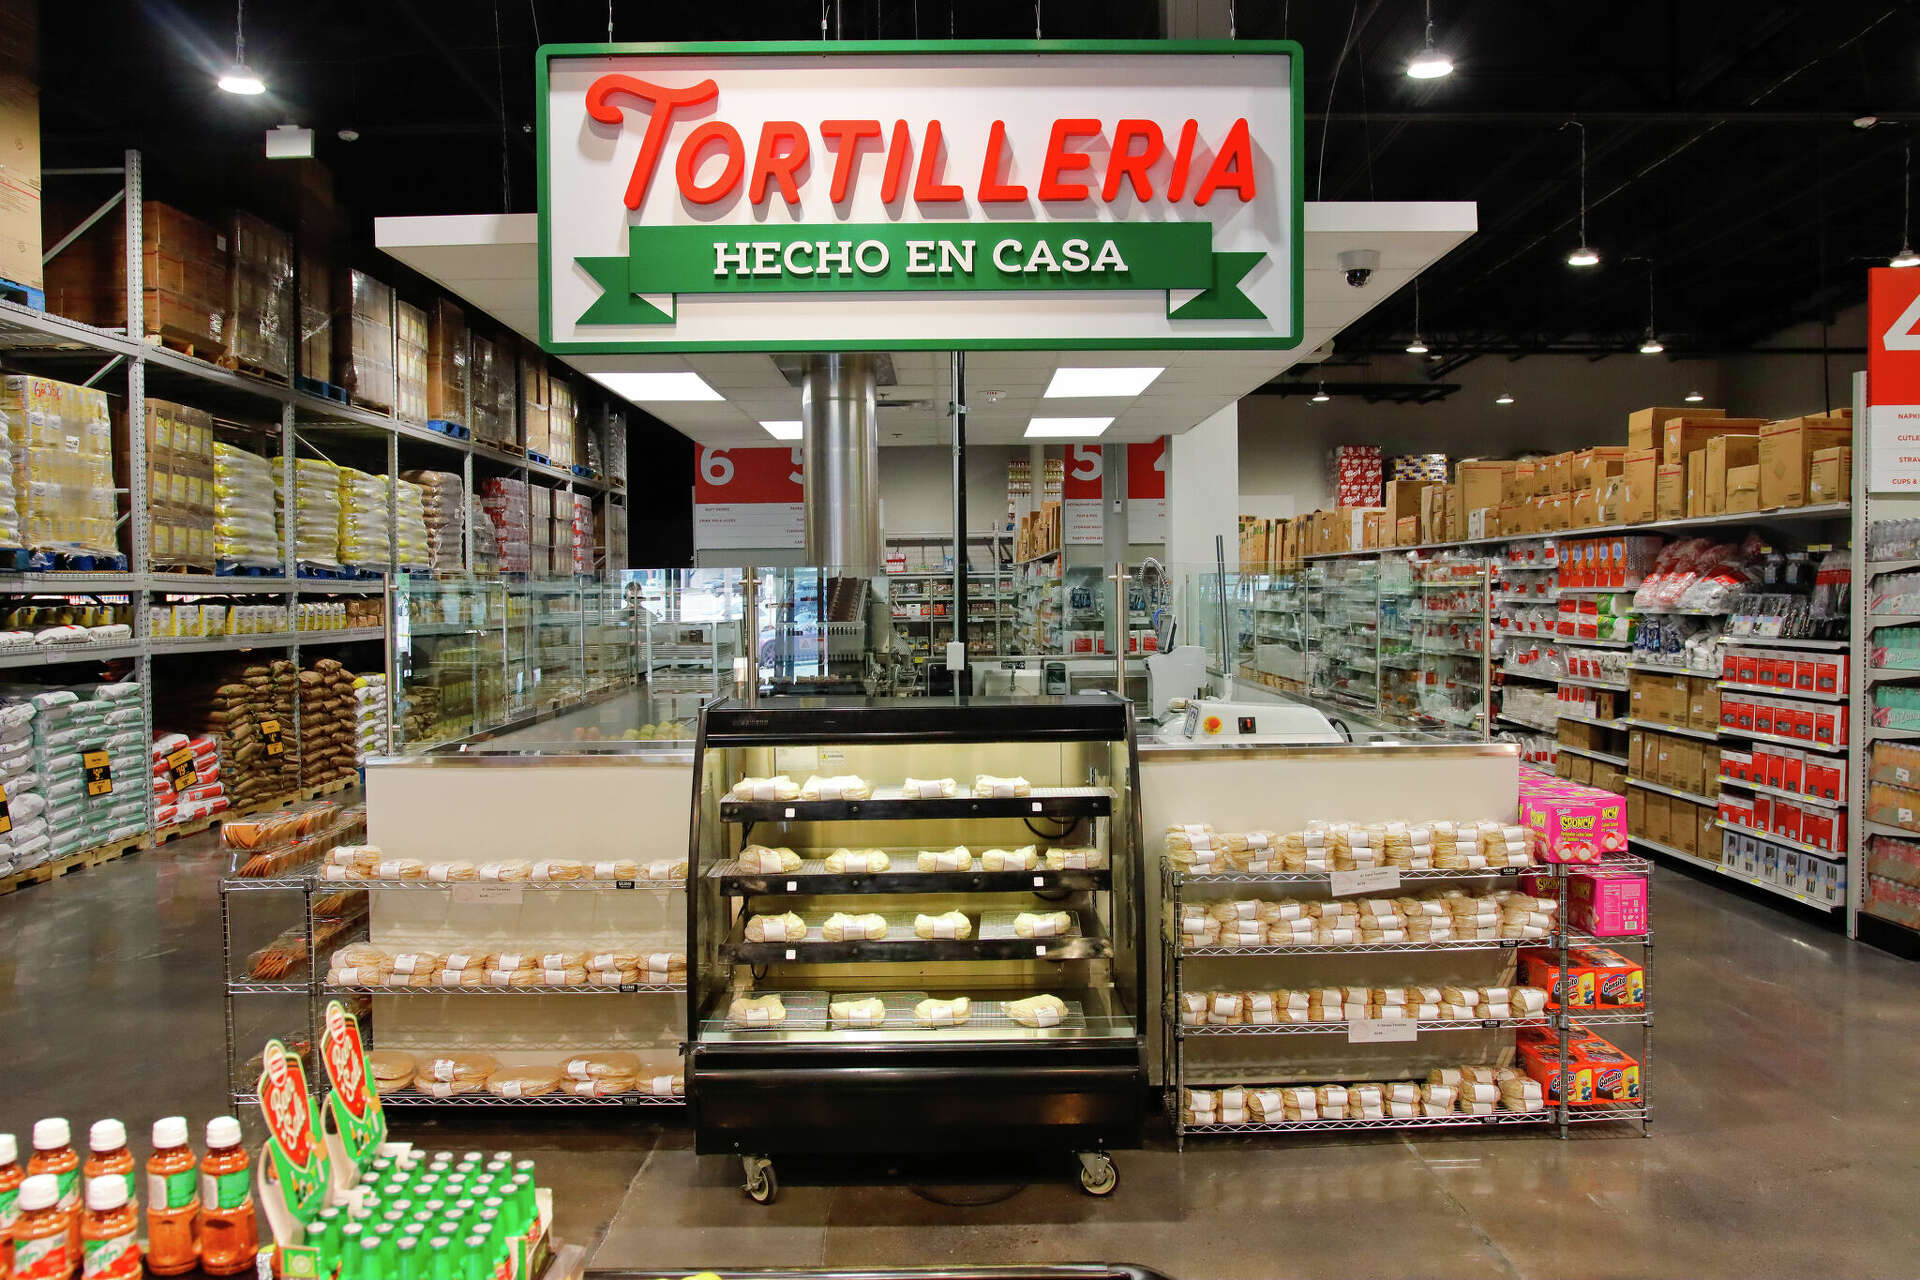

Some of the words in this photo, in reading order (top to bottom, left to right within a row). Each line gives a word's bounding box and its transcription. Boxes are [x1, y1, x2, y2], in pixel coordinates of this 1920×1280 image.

[586, 73, 1256, 211] TORTILLERIA
[713, 239, 890, 277] HECHO
[905, 239, 976, 275] EN
[992, 238, 1130, 274] CASA
[701, 447, 735, 486] 6
[1601, 806, 1620, 820] NCH
[1560, 815, 1596, 831] SPONCH
[1603, 976, 1626, 993] Gansito
[1598, 1071, 1622, 1088] Gansito
